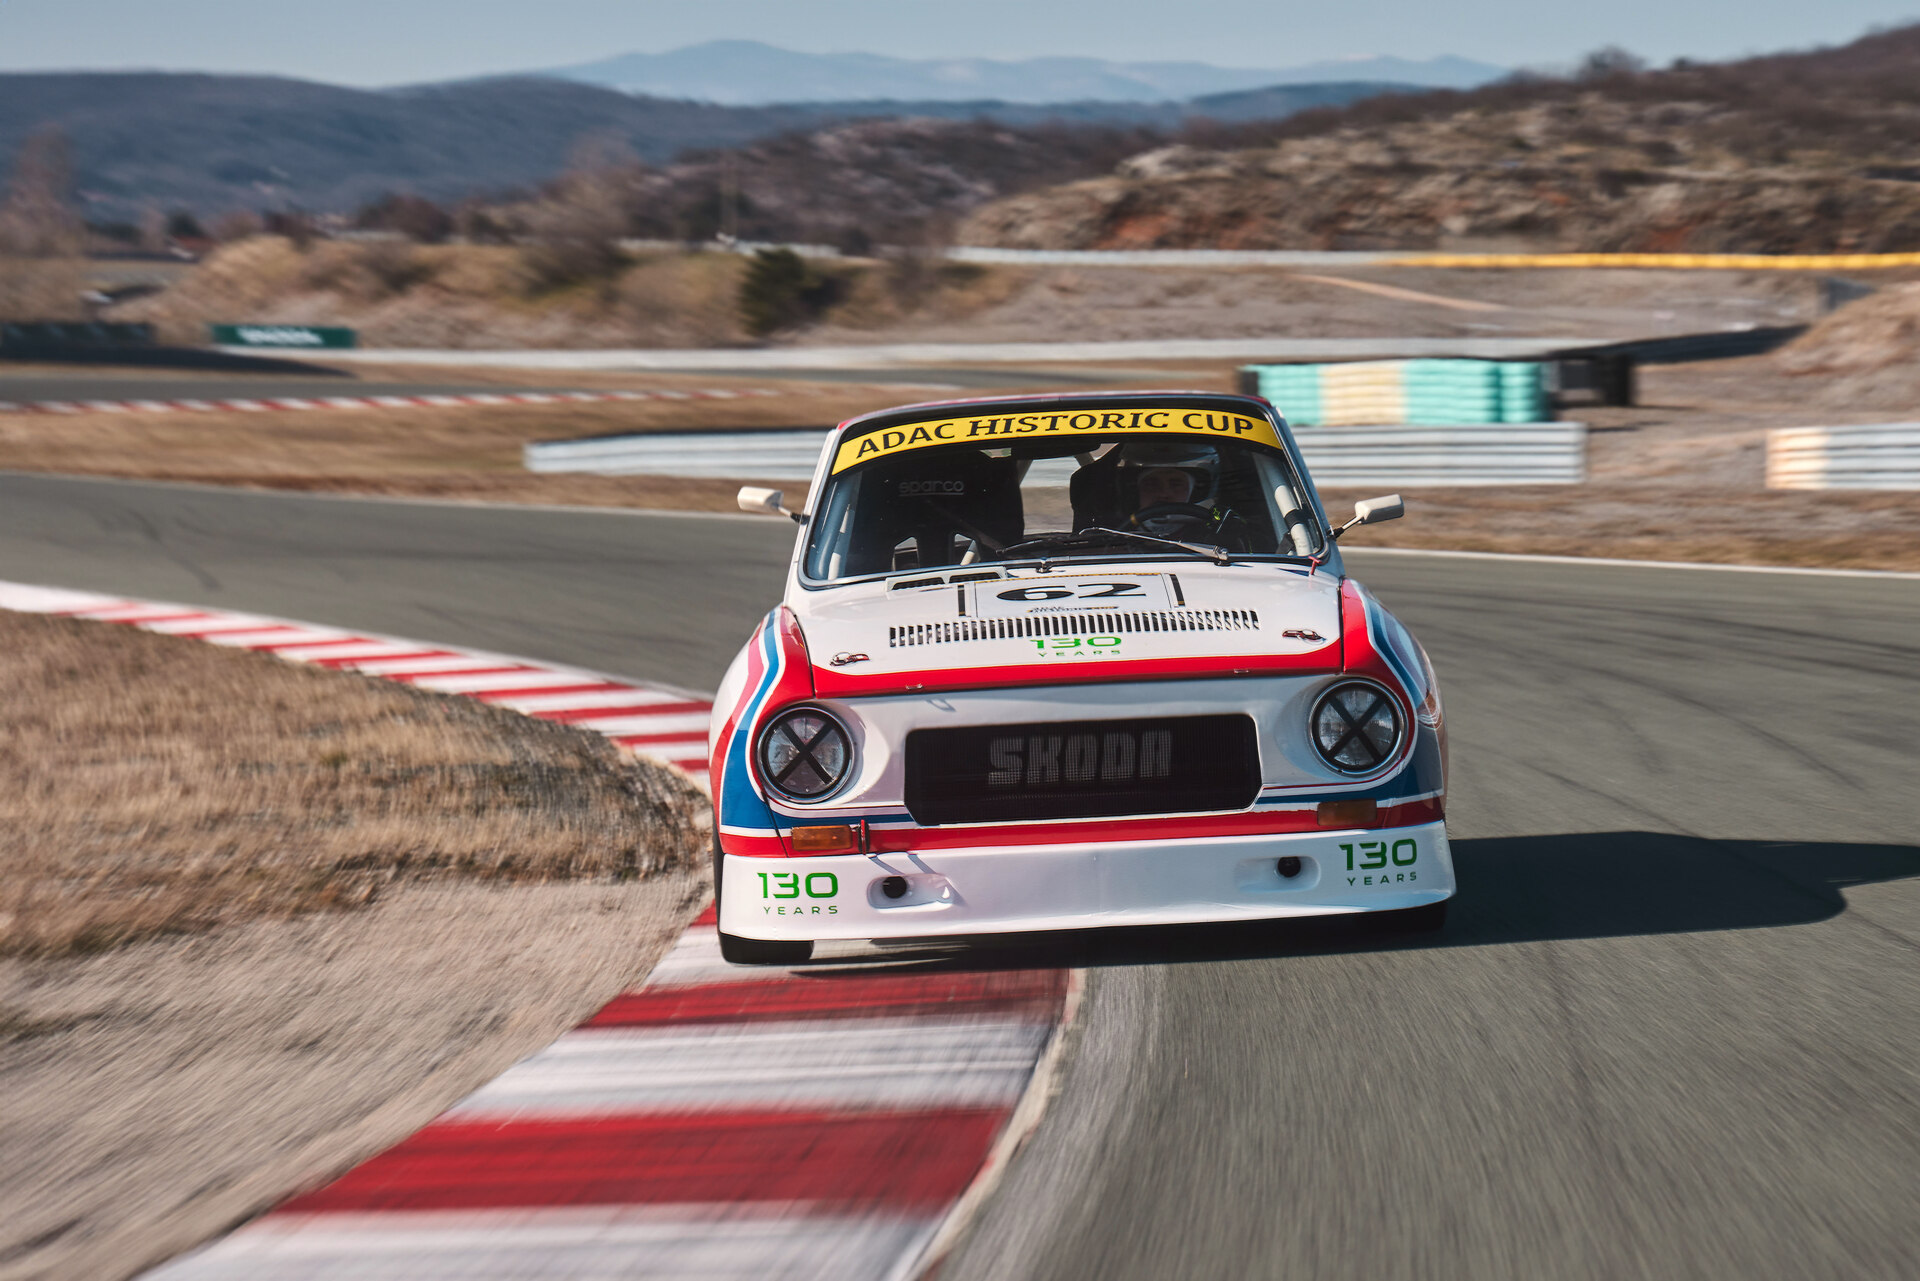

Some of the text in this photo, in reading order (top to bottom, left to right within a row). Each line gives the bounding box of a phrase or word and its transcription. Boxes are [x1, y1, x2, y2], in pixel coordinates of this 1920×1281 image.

[856, 412, 1254, 459] ADAC HISTORIC CUP
[900, 480, 965, 496] sparco
[996, 582, 1147, 601] 62
[1030, 636, 1122, 649] 130
[1037, 650, 1121, 658] YEARS
[988, 729, 1173, 785] SKODA
[1338, 838, 1418, 871] 130
[756, 872, 839, 899] 130
[1346, 871, 1418, 887] YEARS
[763, 905, 839, 915] YEARS
